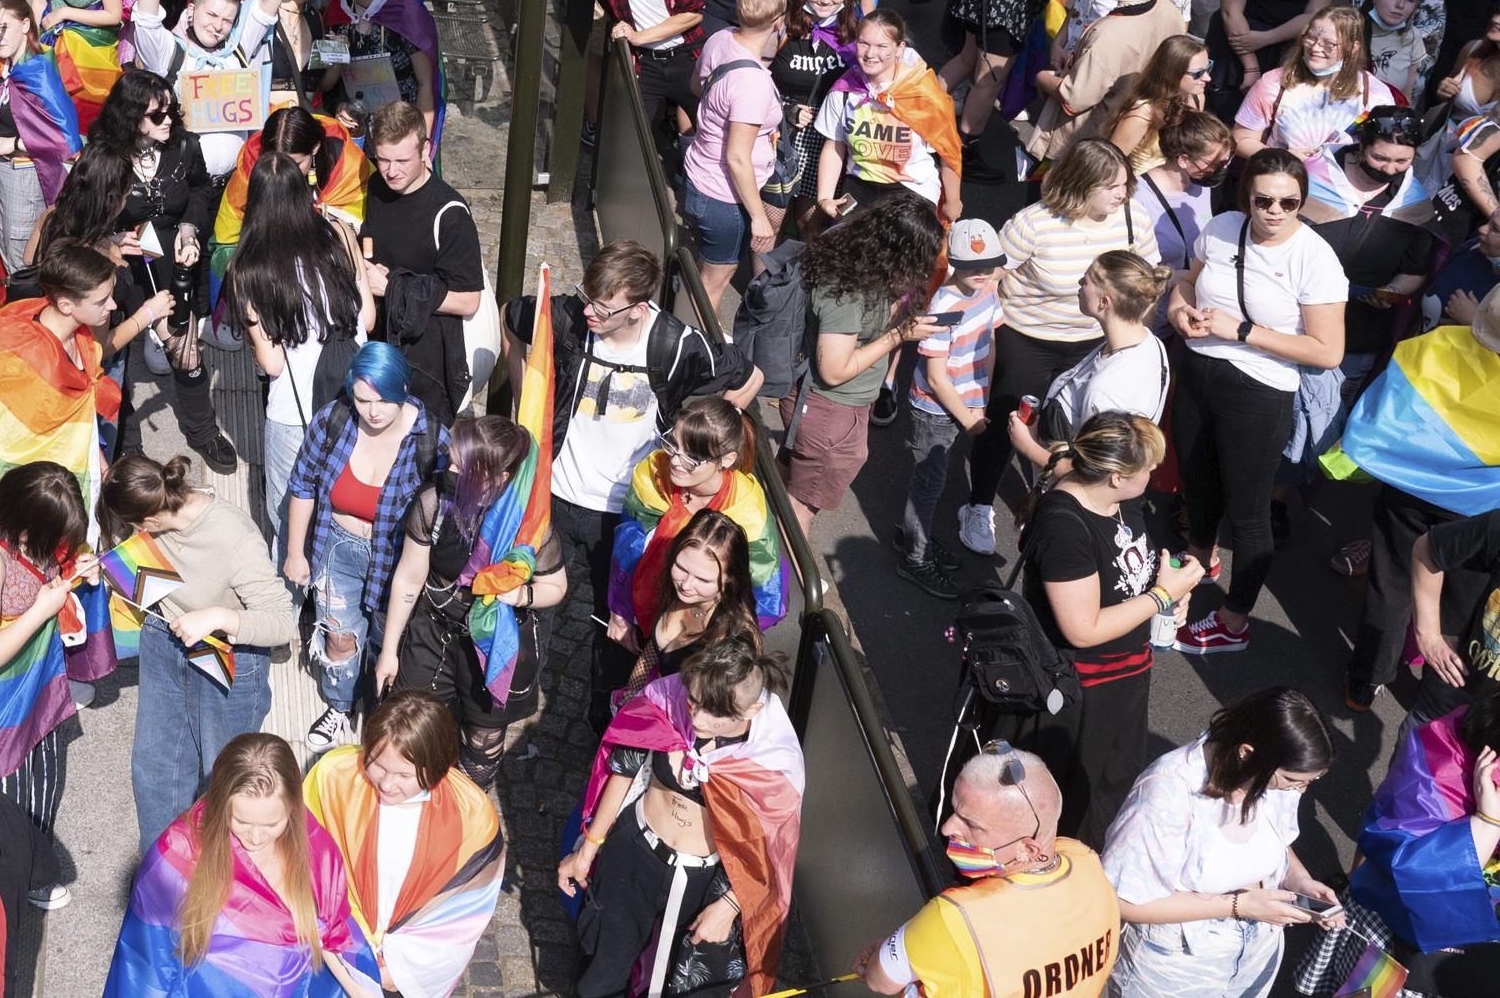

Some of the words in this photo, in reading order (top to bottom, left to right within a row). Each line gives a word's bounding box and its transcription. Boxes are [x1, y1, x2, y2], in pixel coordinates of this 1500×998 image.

[790, 52, 845, 75] angel
[189, 73, 252, 100] FREE
[191, 99, 253, 124] HUGS
[844, 117, 911, 143] SAME
[853, 139, 912, 163] OVE
[1022, 928, 1112, 998] ORDNER
